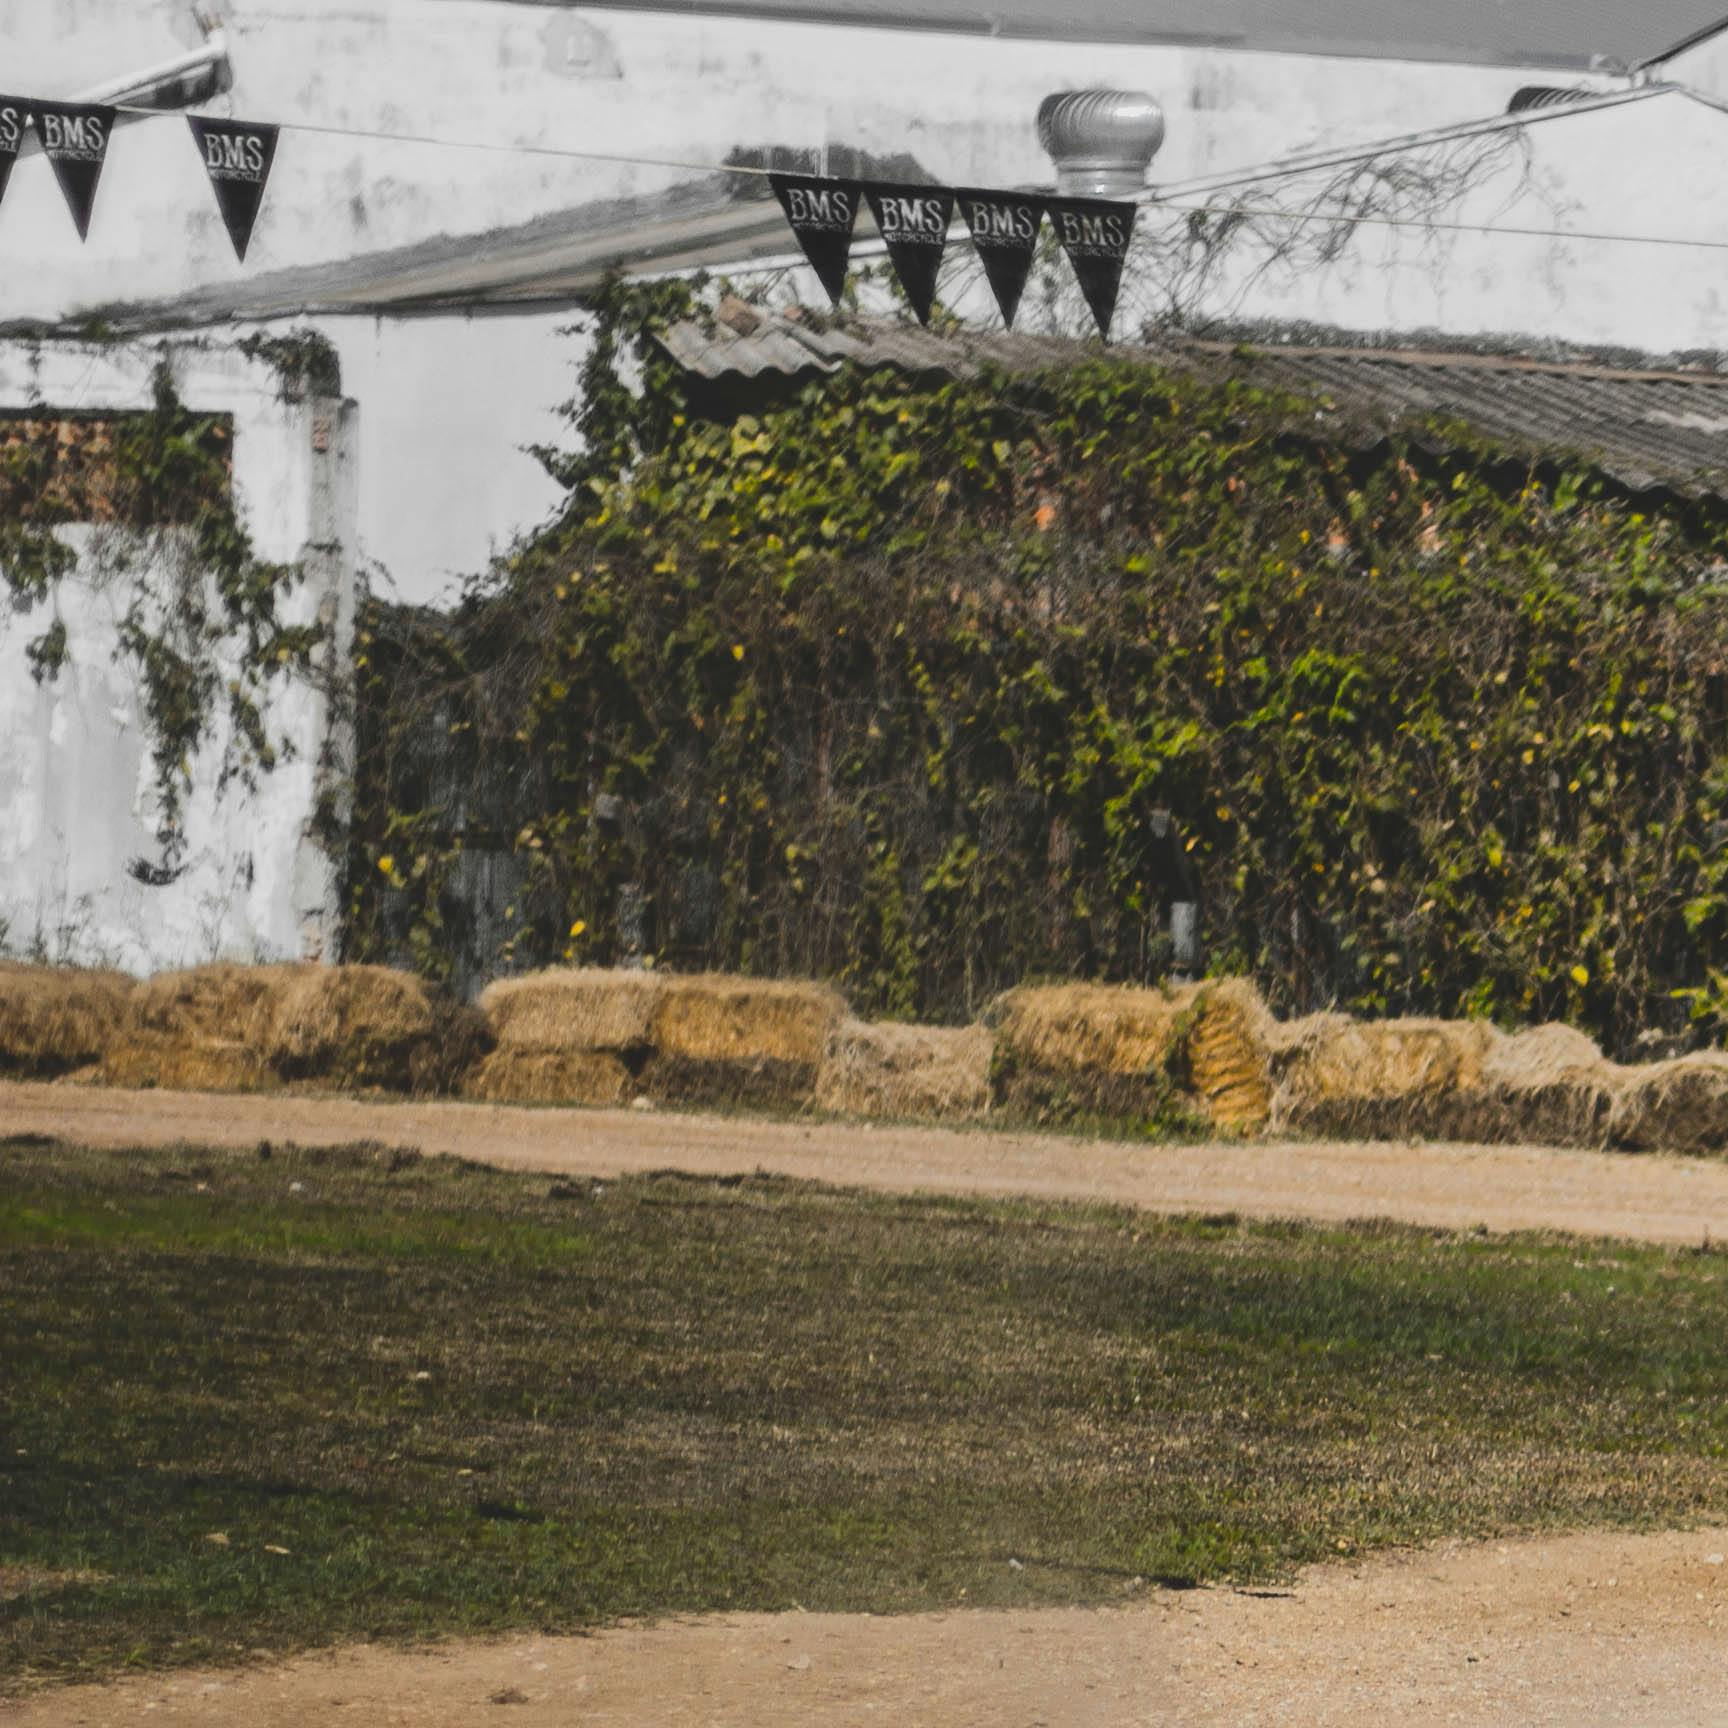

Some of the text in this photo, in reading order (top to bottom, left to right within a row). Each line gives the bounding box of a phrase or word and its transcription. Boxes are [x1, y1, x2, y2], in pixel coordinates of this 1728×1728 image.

[43, 114, 104, 151] BMS
[204, 133, 263, 172] BMS
[787, 188, 850, 223] BMS
[879, 198, 944, 233] BMS
[970, 202, 1034, 239] BMS
[1061, 212, 1124, 247] BMS
